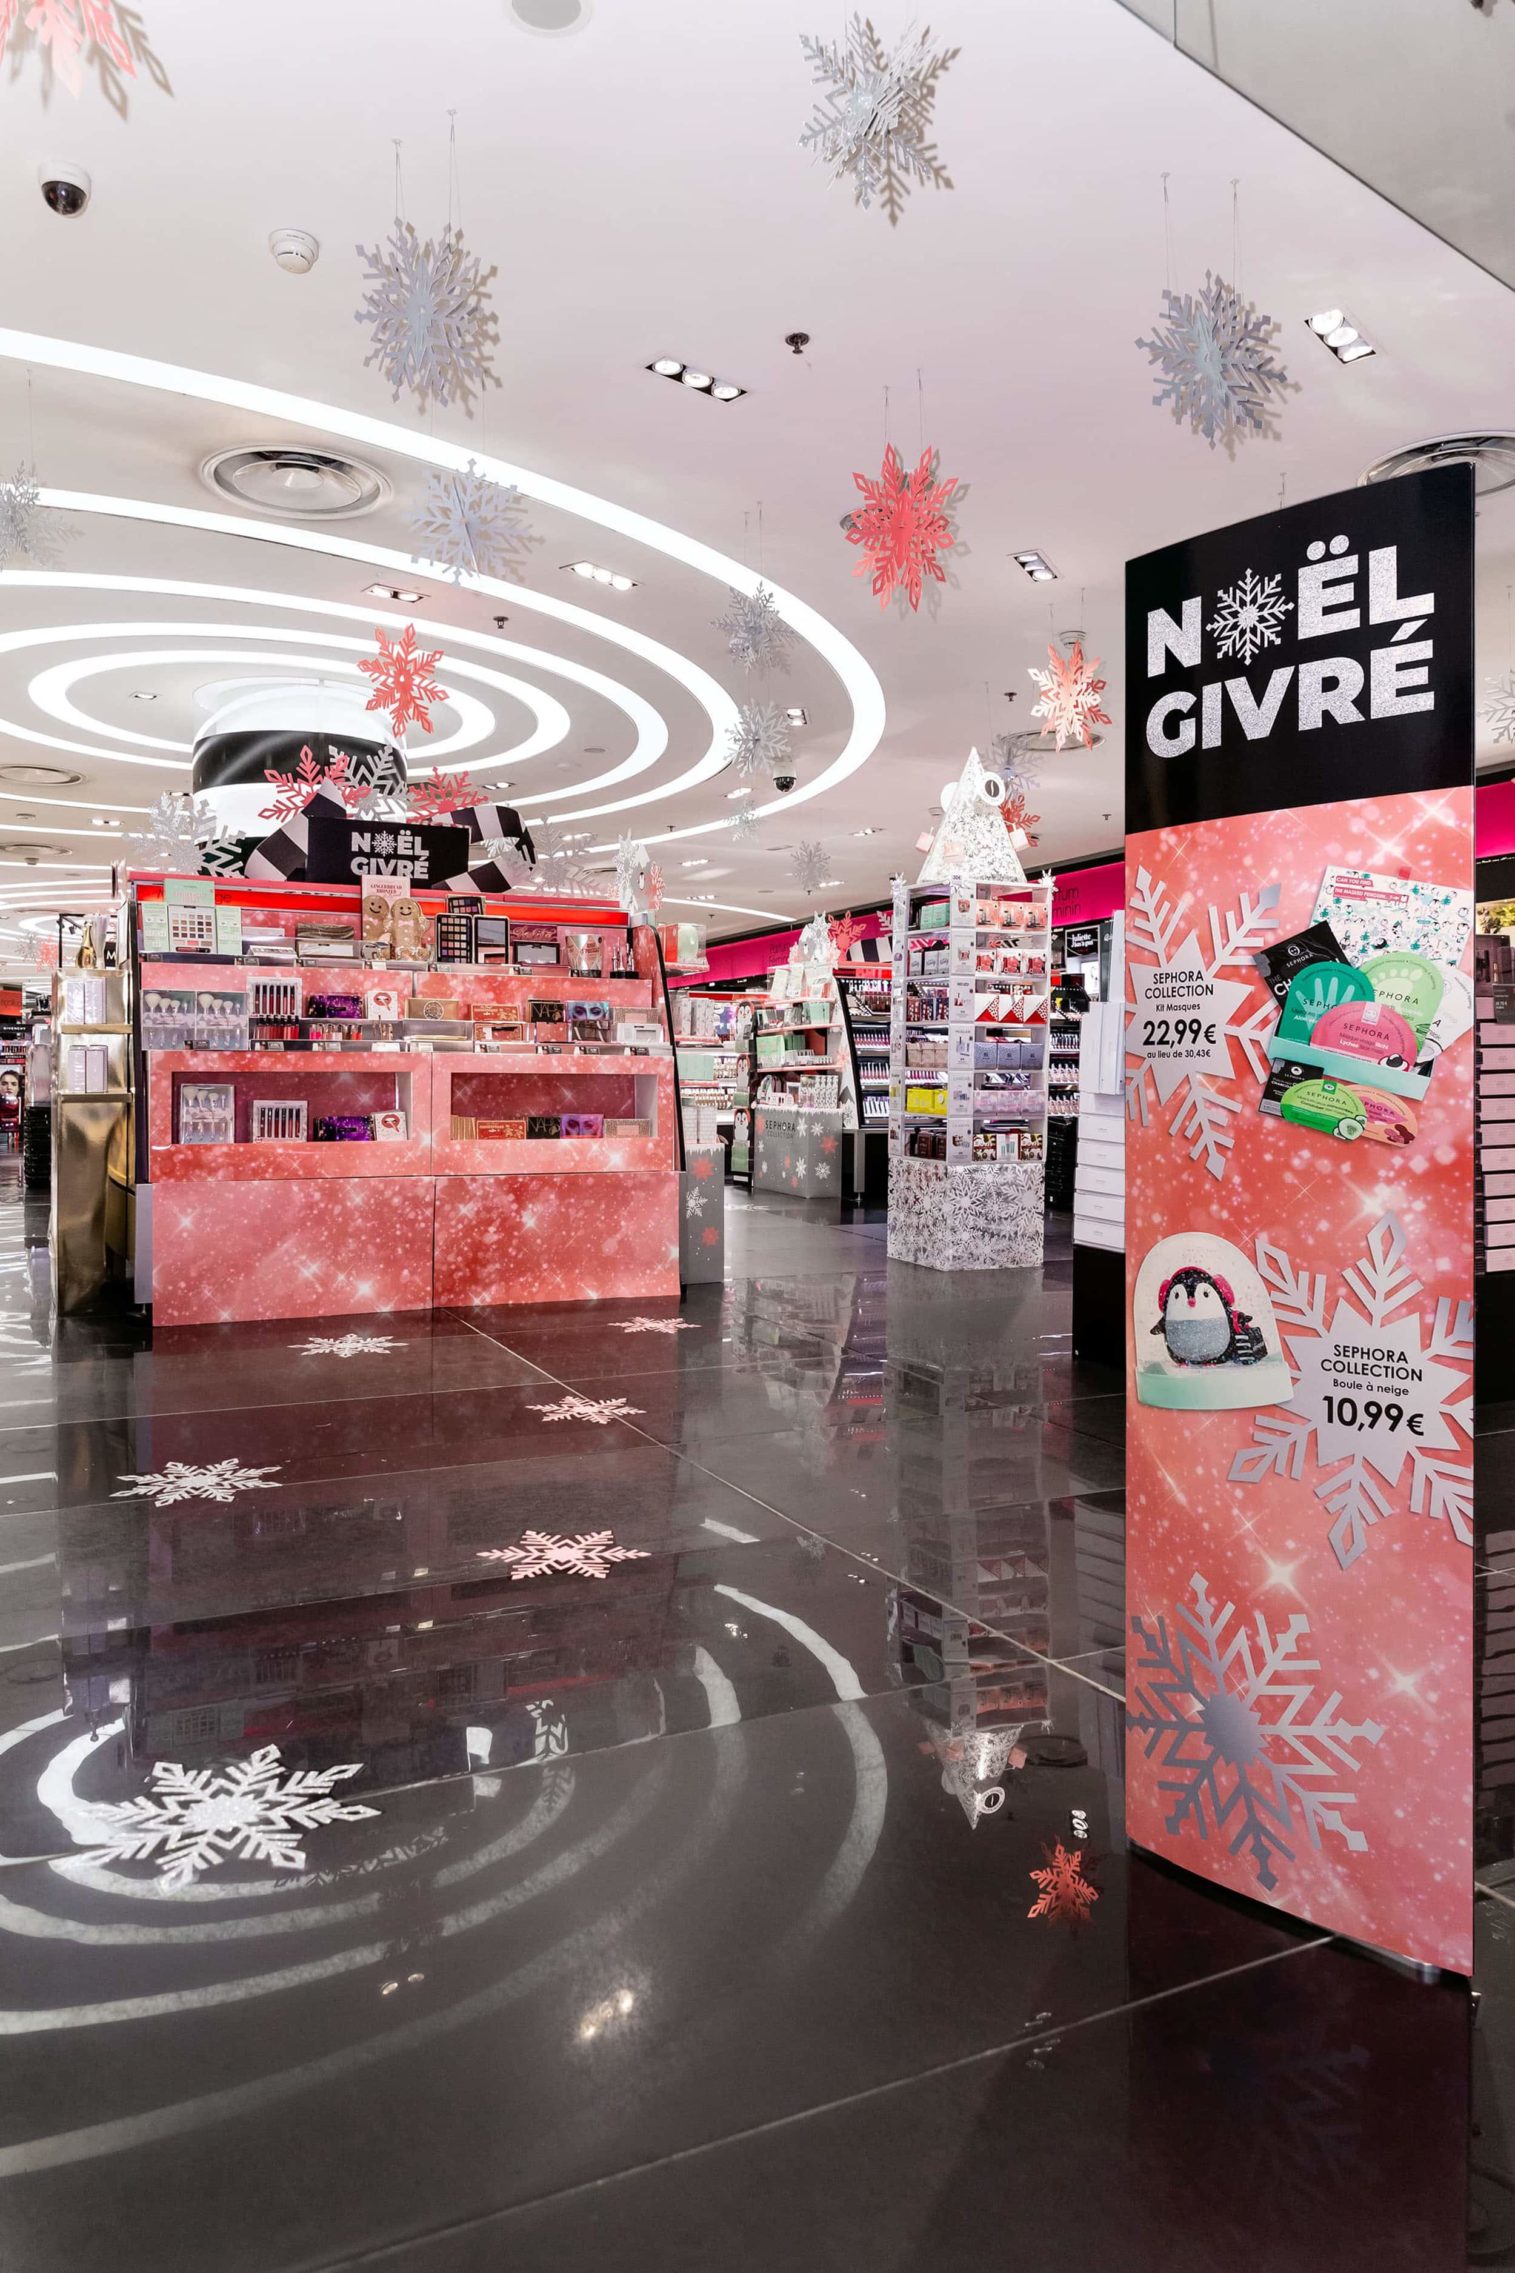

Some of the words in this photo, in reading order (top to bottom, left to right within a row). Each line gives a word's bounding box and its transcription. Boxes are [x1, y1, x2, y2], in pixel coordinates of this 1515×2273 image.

[1146, 618, 1435, 759] GIVRÉ
[350, 856, 429, 879] GIVRÉ
[1286, 953, 1314, 968] SEPHORA
[1153, 970, 1204, 985] SEPHORA
[1145, 984, 1214, 999] COLLECTION
[1156, 1003, 1164, 1012] Kit
[1166, 1003, 1201, 1012] Masques
[1143, 1018, 1216, 1049] 22,99€
[1343, 1022, 1390, 1040] SEPHORA
[1147, 1051, 1156, 1059] au
[1157, 1050, 1171, 1058] lieu
[1172, 1050, 1183, 1058] de
[1306, 1091, 1347, 1106] SEPHORA
[1364, 1101, 1396, 1115] PHORA
[765, 1119, 796, 1132] SEPHORA
[1333, 1344, 1409, 1364] SEPHORA
[1320, 1359, 1423, 1382] COLLECTION
[1333, 1378, 1363, 1390] Boule
[1366, 1381, 1374, 1391] à
[1377, 1384, 1410, 1397] neige
[1322, 1395, 1425, 1436] 10,99€
